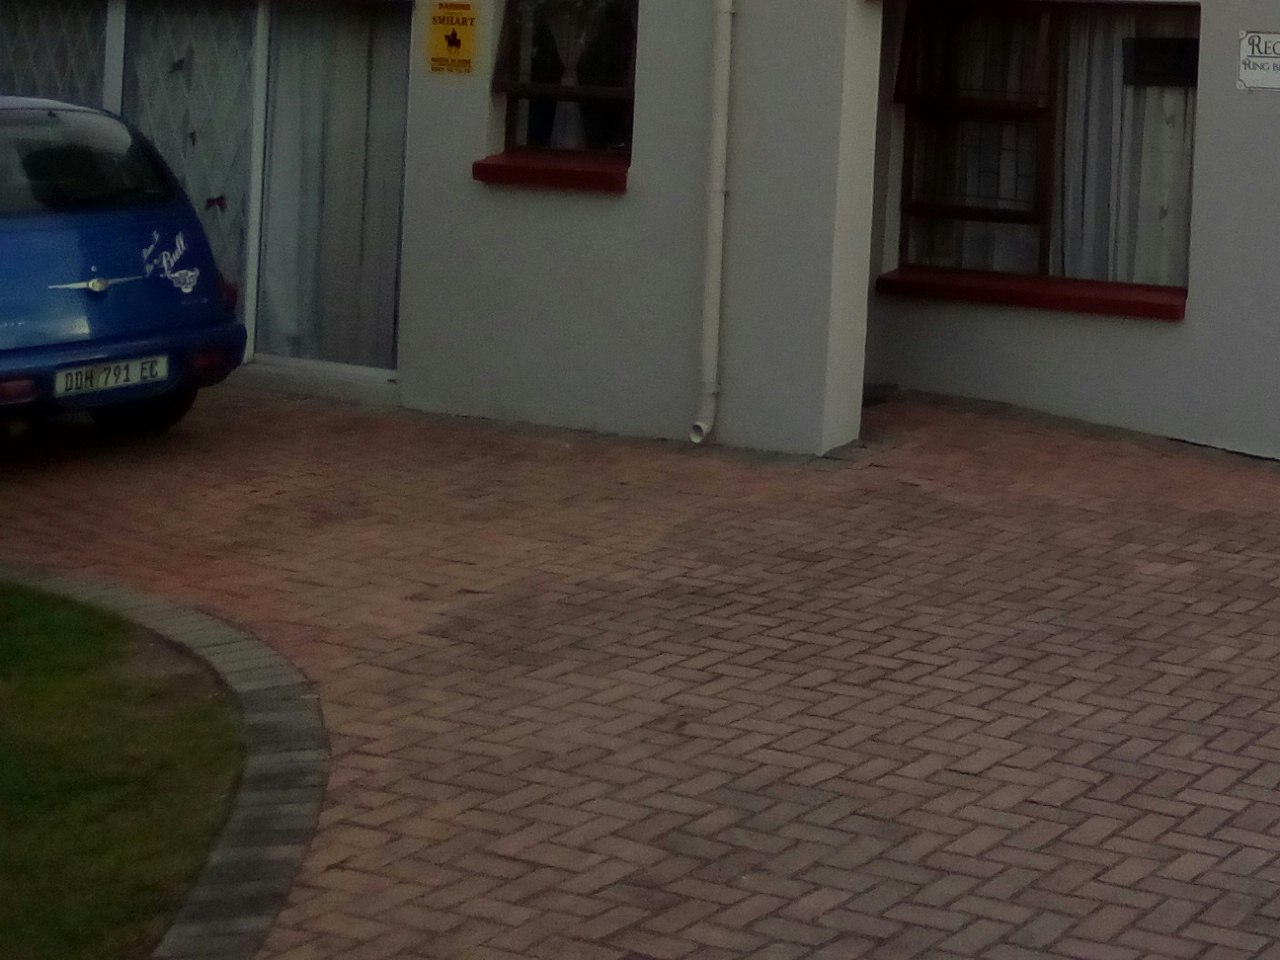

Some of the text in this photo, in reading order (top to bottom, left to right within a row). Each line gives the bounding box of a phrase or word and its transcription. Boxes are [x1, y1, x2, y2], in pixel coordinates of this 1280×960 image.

[1242, 58, 1270, 71] RING
[103, 363, 131, 386] 791
[140, 359, 159, 380] EC
